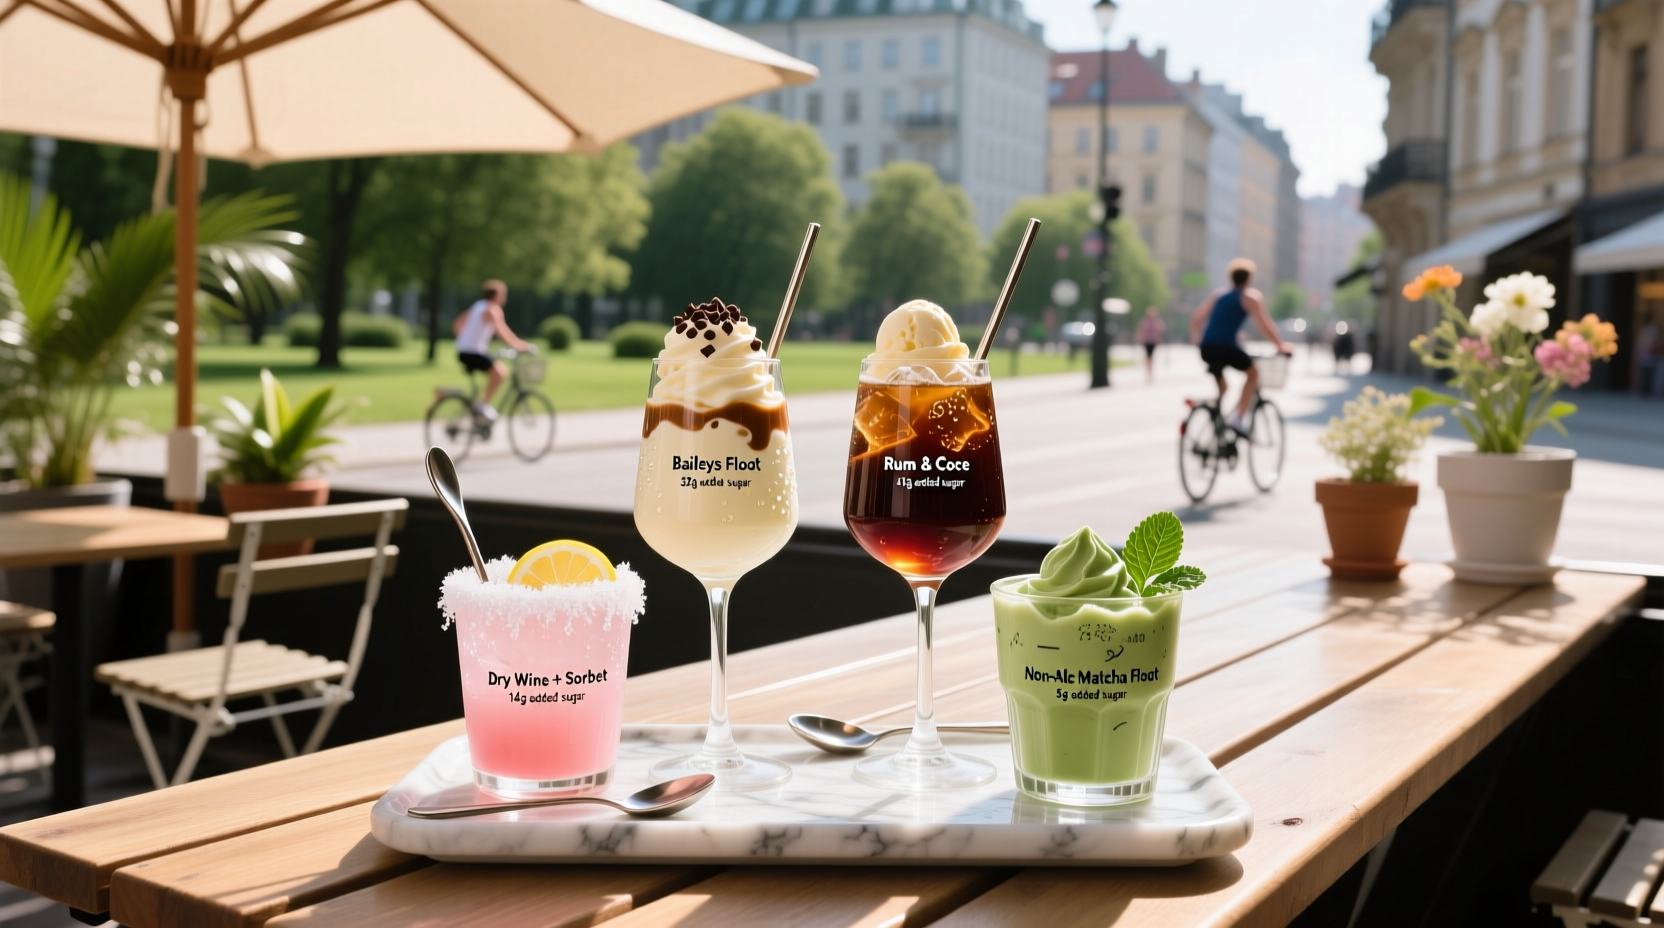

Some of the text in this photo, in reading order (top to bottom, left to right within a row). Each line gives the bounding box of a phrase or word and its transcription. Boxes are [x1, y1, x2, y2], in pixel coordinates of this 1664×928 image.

[672, 455, 722, 474] Baileys
[884, 456, 917, 471] Rum
[920, 455, 932, 471] &
[488, 669, 608, 689] Dry Wine + Sorbet
[1078, 669, 1127, 685] Matcha
[508, 691, 527, 705] 14g
[561, 693, 586, 704] sugar
[1056, 688, 1068, 701] 5g
